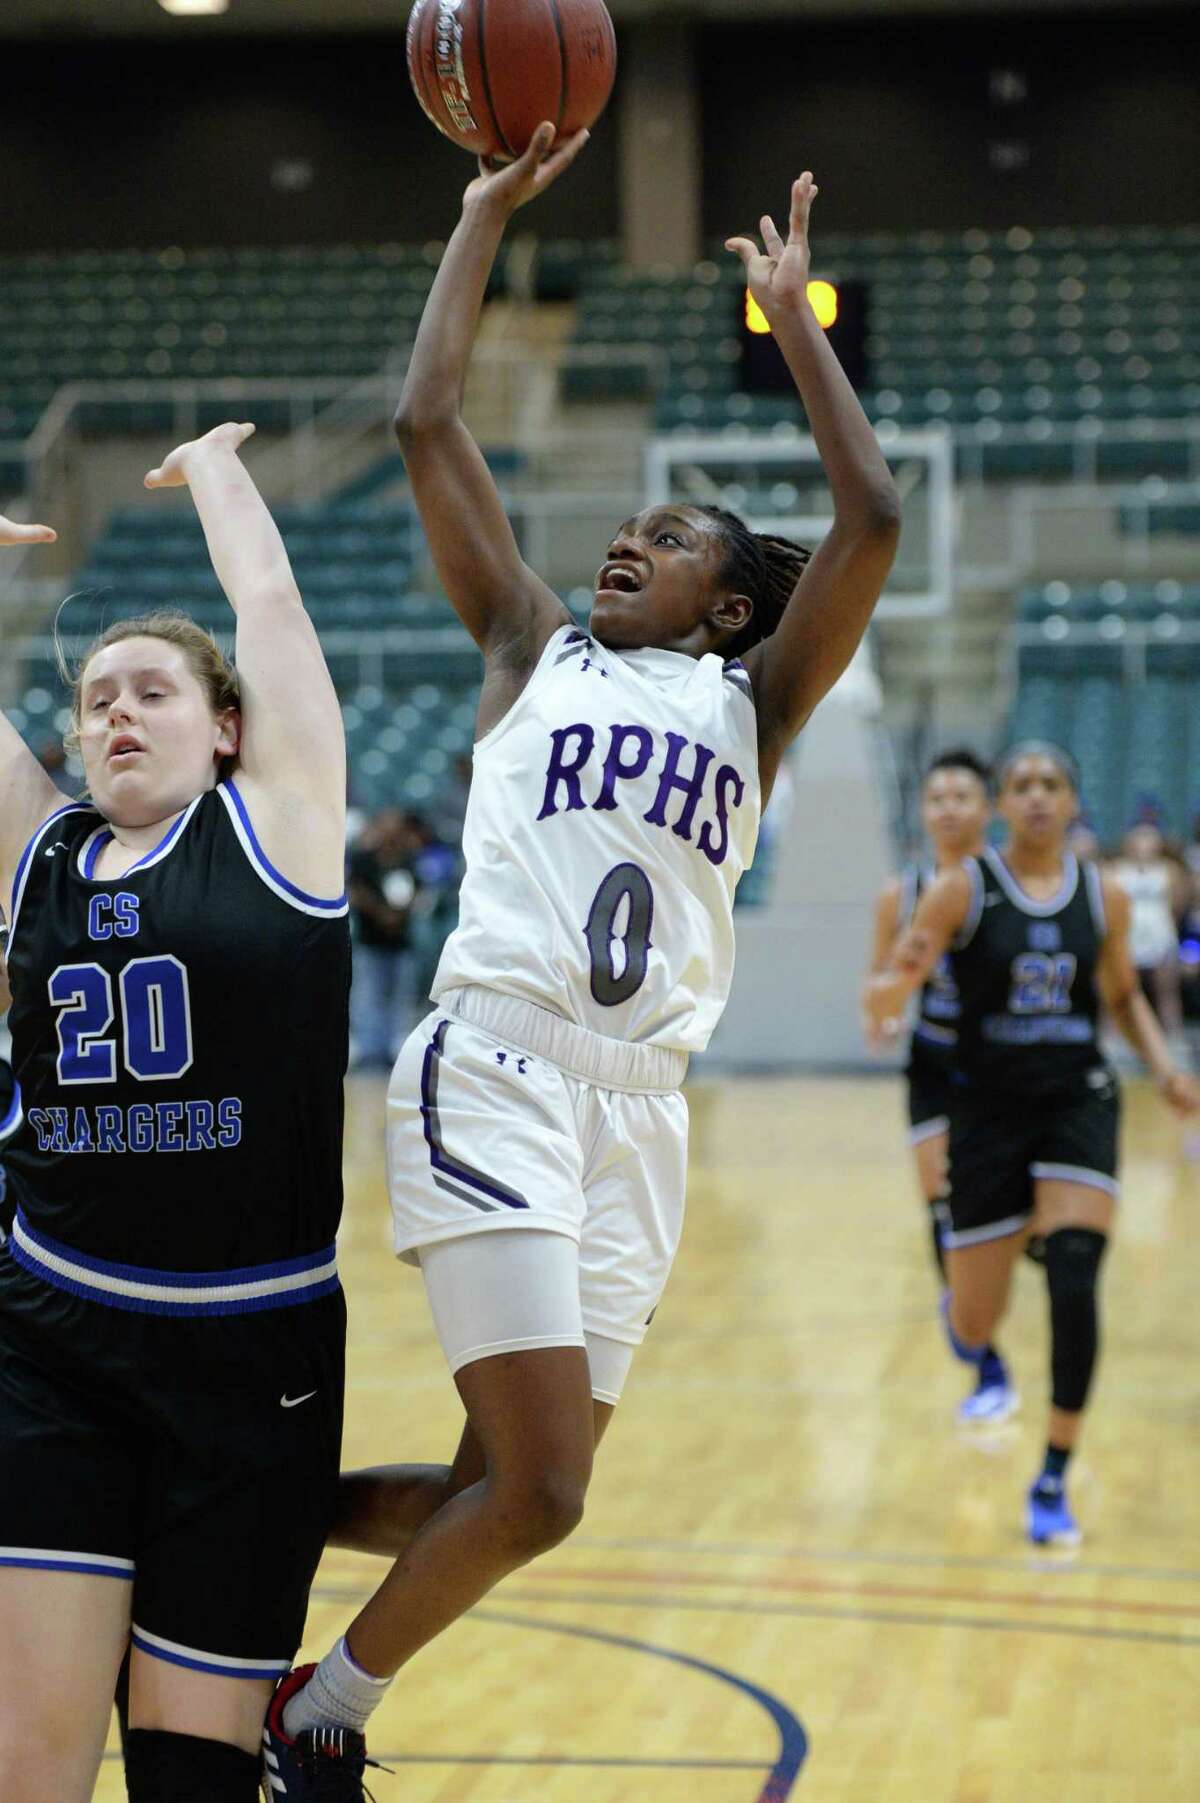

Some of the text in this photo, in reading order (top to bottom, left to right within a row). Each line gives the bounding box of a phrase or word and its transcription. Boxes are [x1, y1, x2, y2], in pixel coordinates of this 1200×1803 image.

[537, 723, 744, 865] RPHS
[88, 892, 139, 940] CS
[583, 862, 653, 1006] 0
[47, 954, 193, 1085] 20
[29, 1097, 242, 1153] CHARGERS
